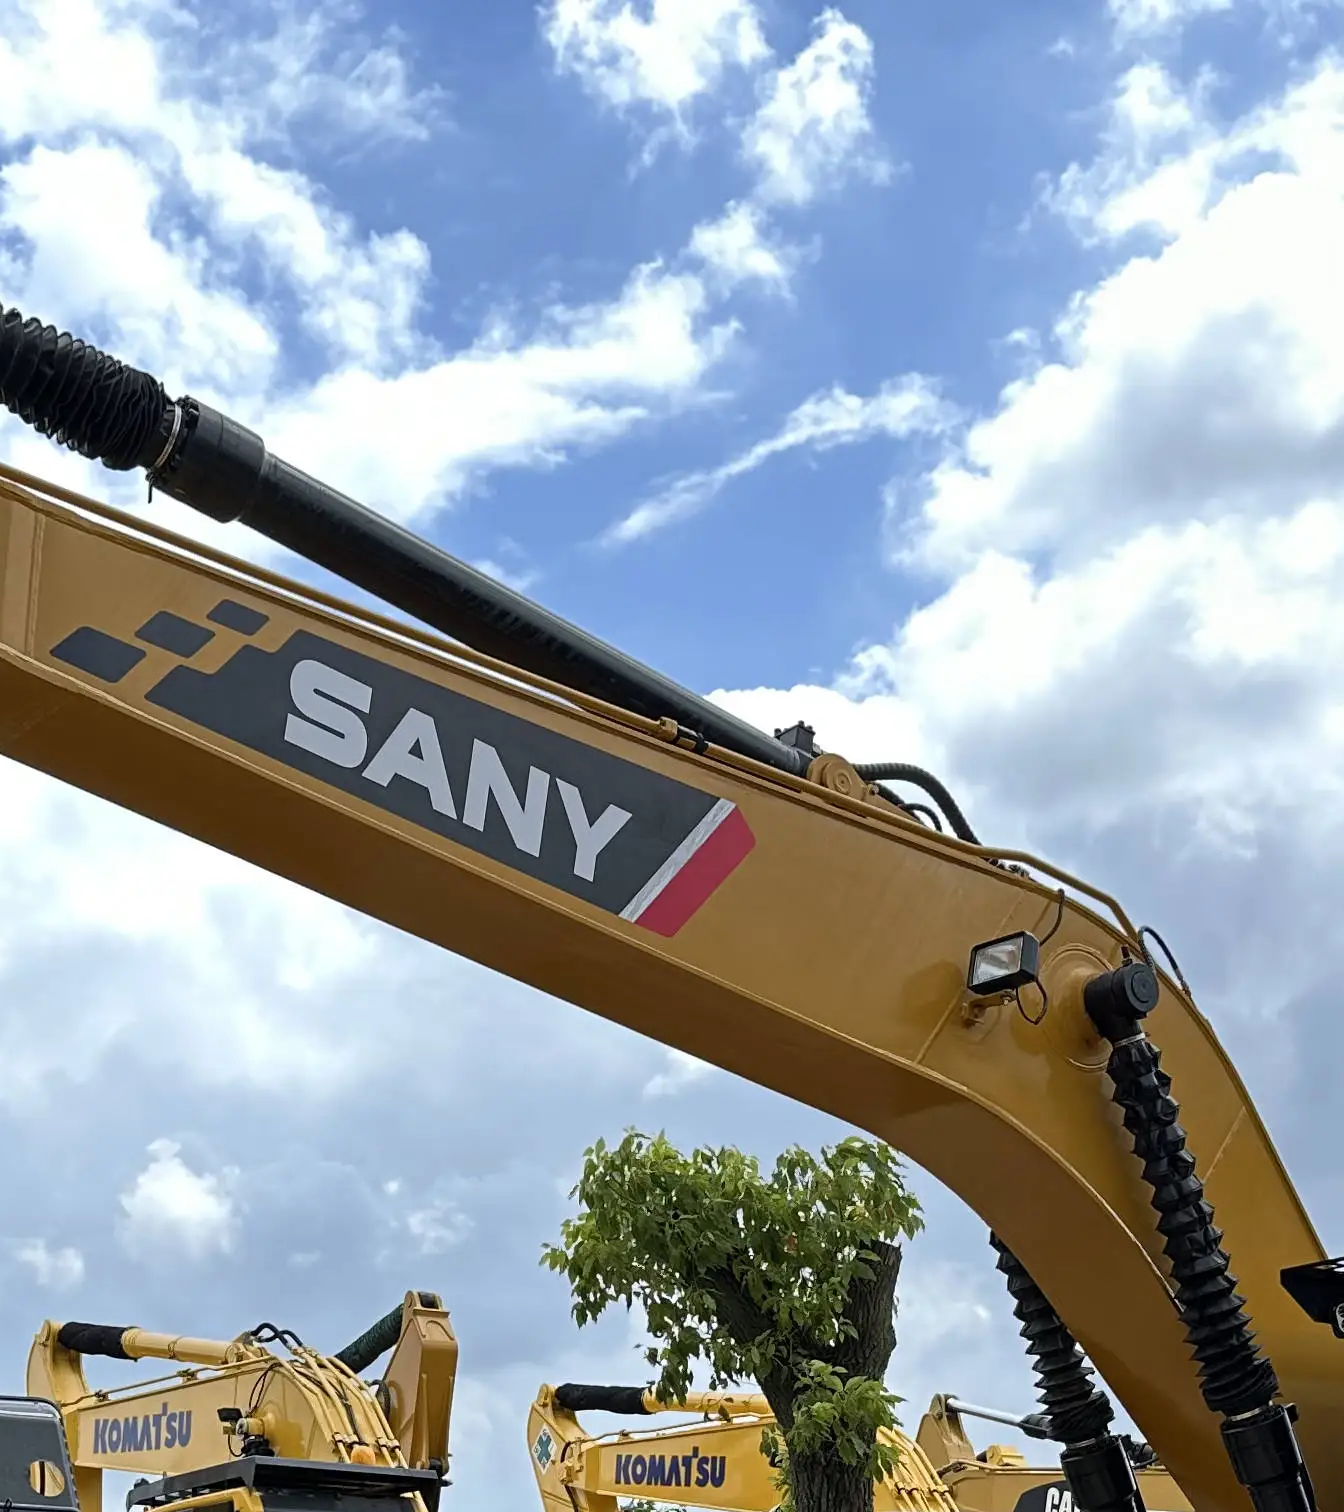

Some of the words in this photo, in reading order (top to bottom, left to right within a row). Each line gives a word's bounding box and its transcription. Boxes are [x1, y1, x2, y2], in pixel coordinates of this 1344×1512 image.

[284, 658, 633, 884] SANY
[93, 1401, 193, 1455] KOMATSU
[614, 1445, 726, 1488] KOMATSU
